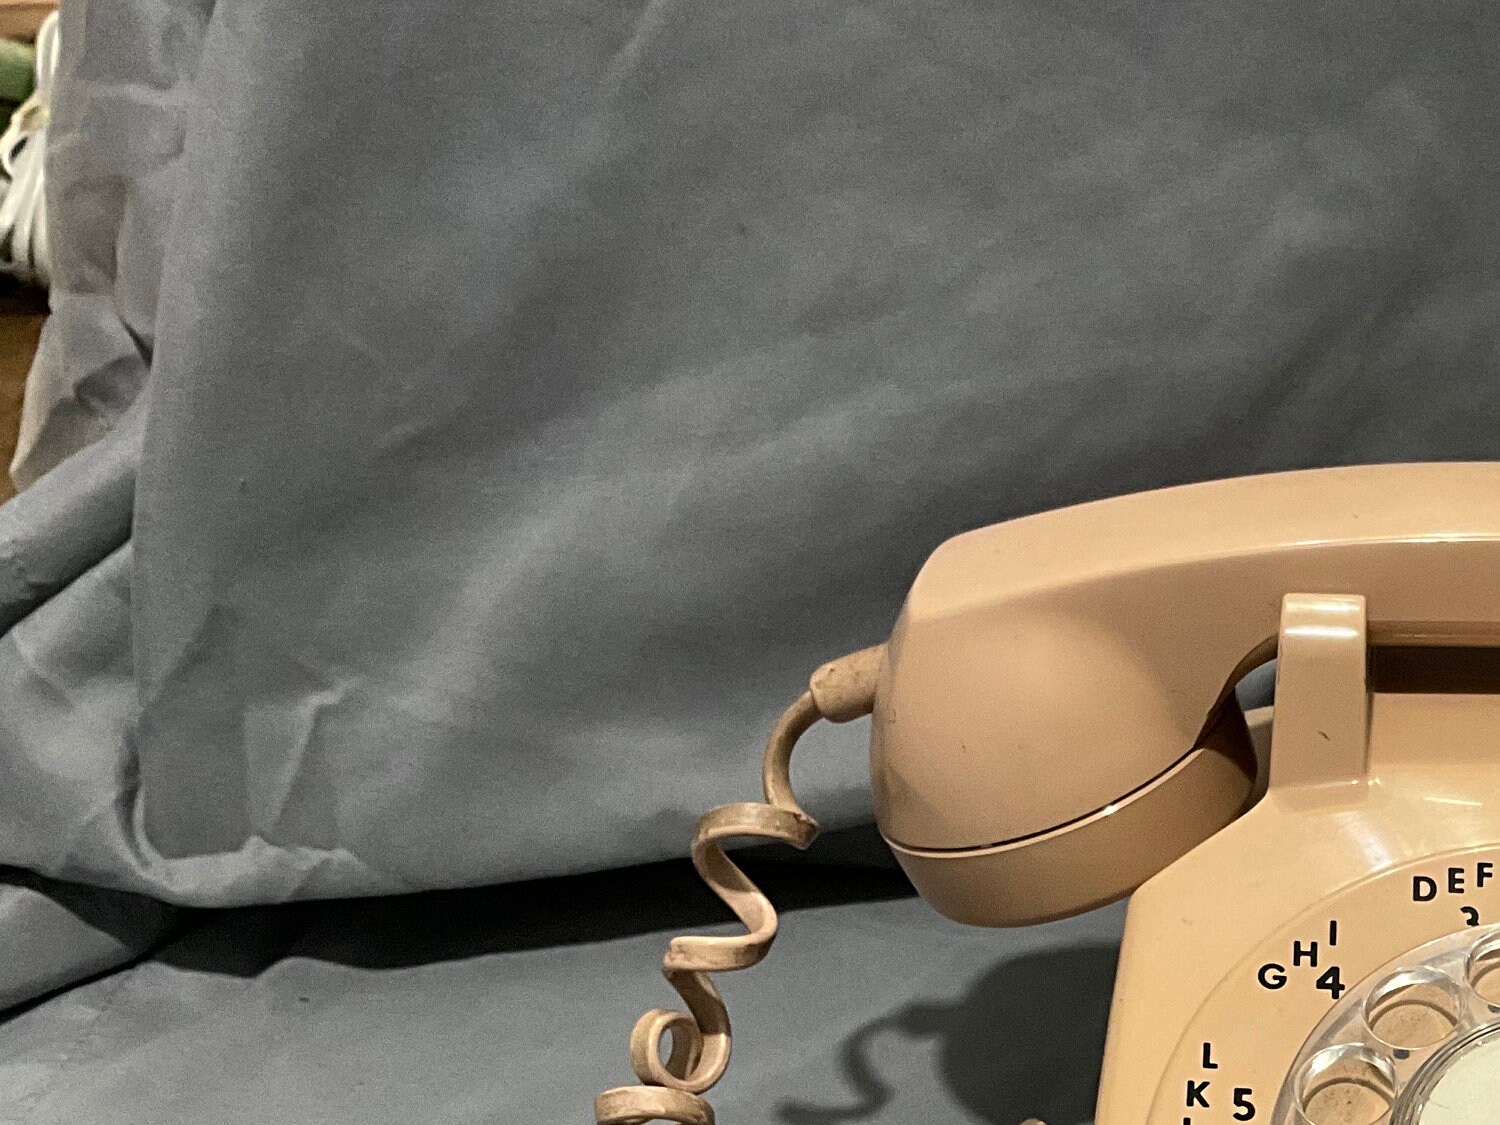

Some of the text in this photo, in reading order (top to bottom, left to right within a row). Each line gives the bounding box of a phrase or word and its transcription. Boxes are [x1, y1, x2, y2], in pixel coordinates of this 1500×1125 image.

[1412, 862, 1494, 902] DEF
[1315, 966, 1345, 999] 4
[1232, 1087, 1256, 1122] 5
